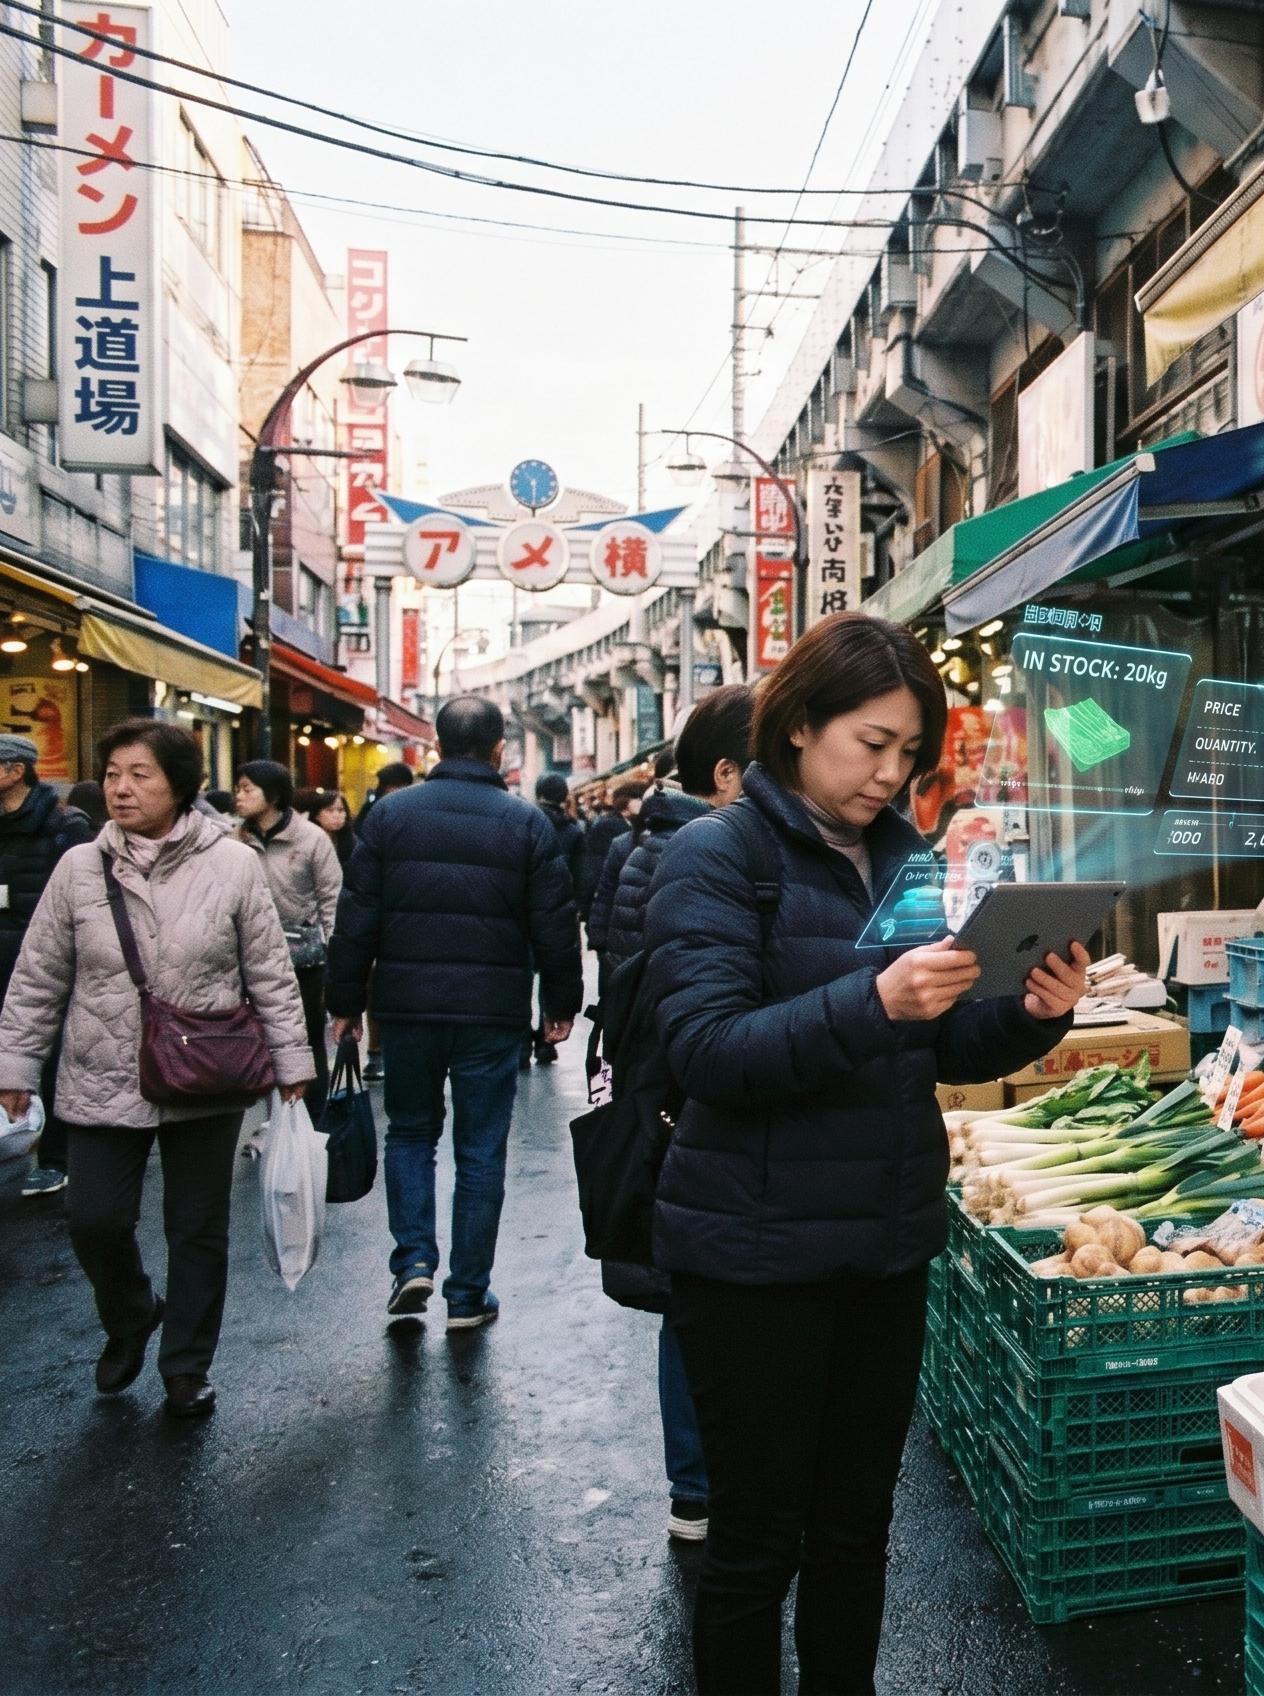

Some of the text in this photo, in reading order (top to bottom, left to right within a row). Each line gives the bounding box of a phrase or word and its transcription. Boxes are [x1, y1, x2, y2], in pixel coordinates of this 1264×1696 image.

[75, 13, 140, 436] カーメン 上道場
[419, 530, 649, 578] アメ横
[1023, 650, 1168, 690] IN STOCK: 20kg
[1203, 700, 1242, 717] PRICE
